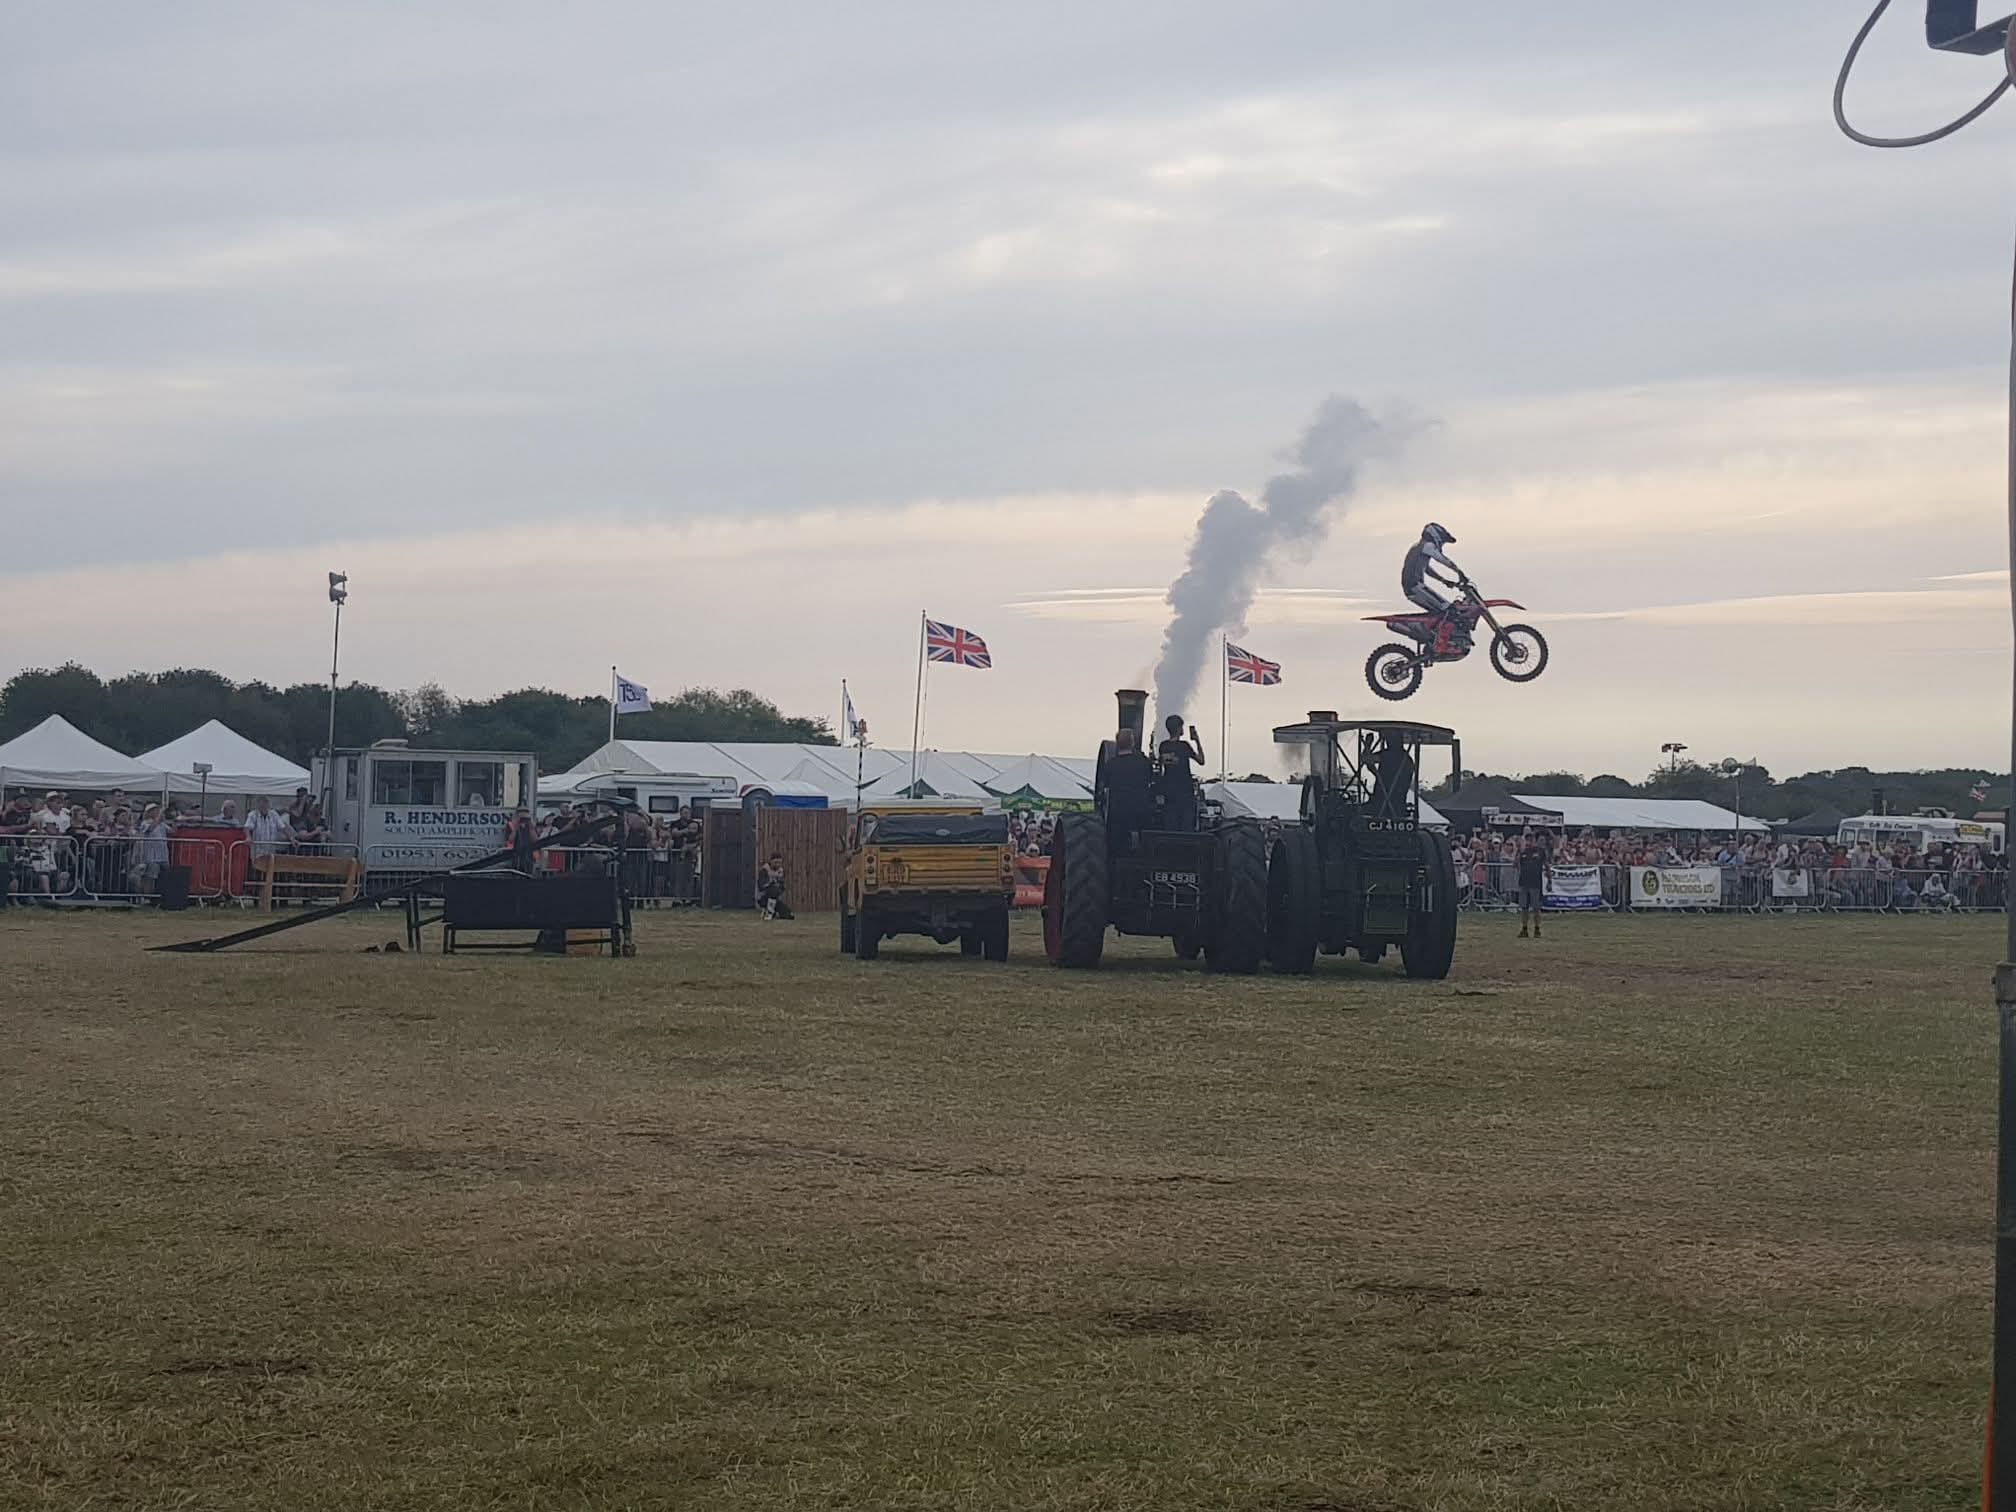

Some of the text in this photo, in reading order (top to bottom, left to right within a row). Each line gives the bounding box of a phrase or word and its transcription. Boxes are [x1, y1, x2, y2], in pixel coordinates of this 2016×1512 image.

[384, 811, 513, 825] R. HENDERSON
[385, 826, 426, 836] SOUND
